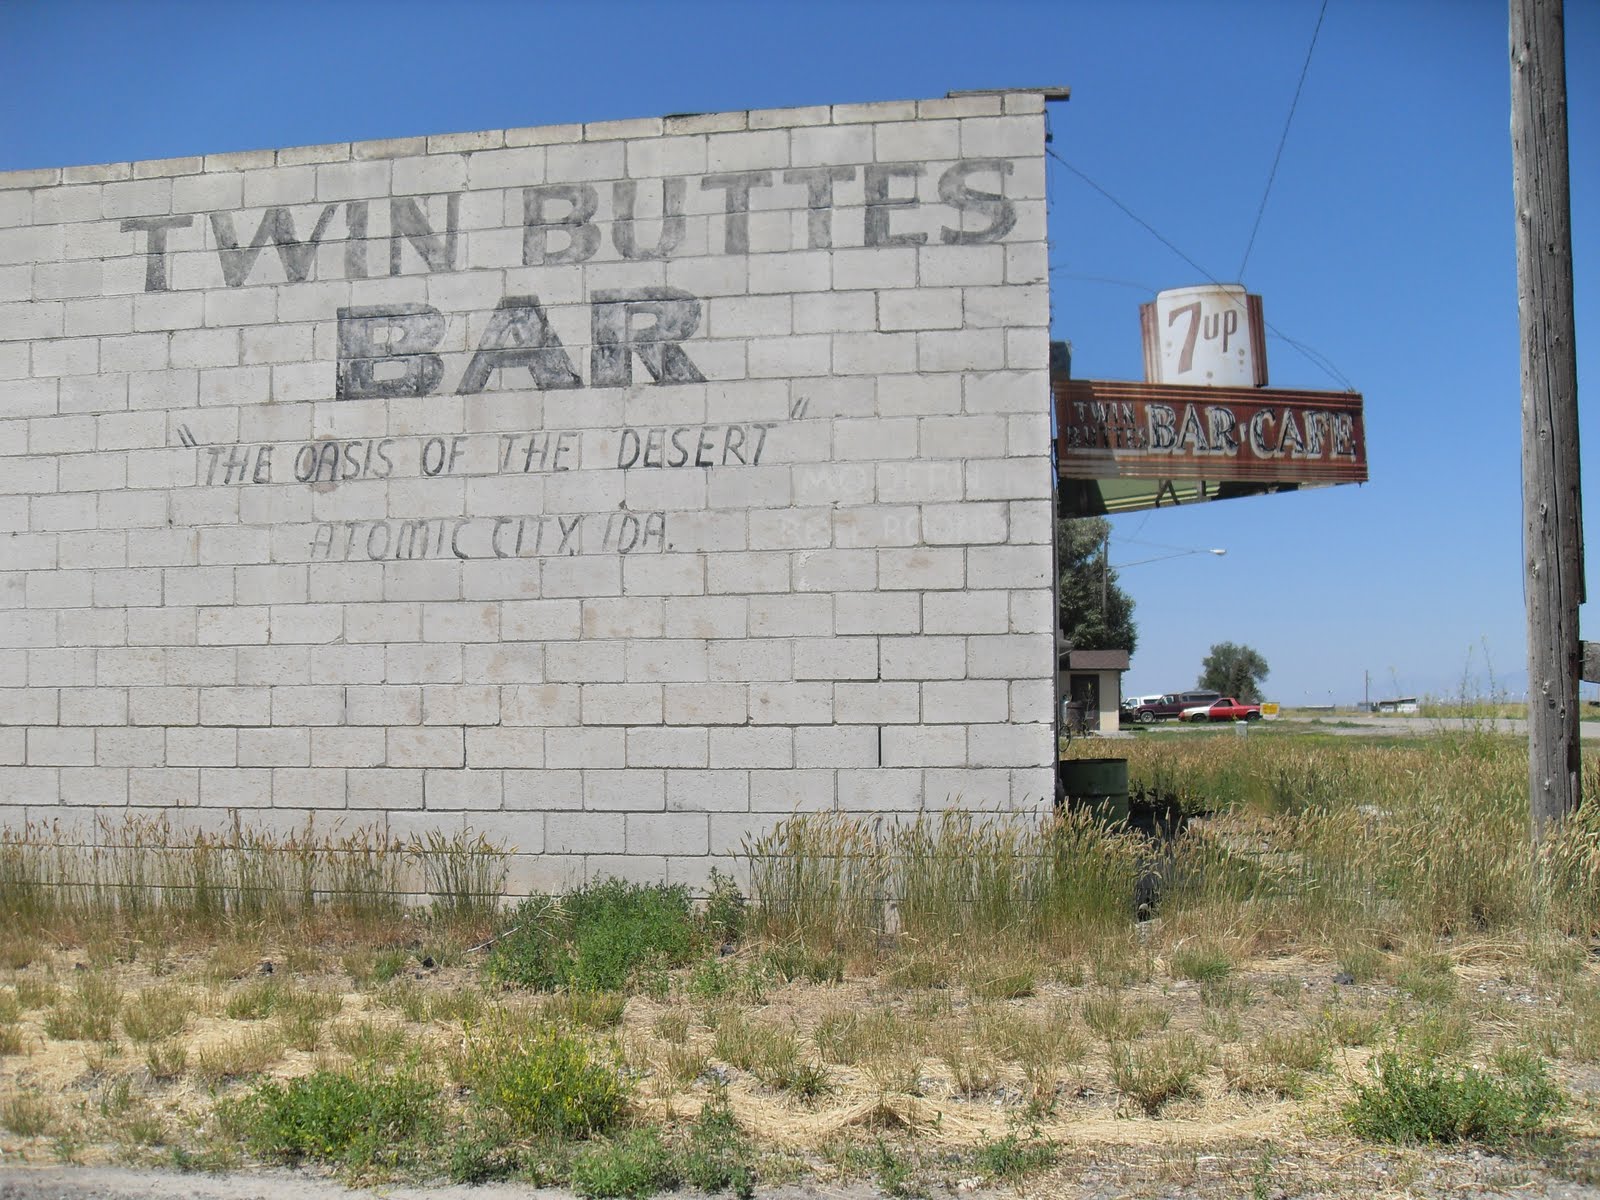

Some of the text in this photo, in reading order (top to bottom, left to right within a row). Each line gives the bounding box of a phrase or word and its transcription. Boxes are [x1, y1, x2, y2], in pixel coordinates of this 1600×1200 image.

[120, 158, 1017, 292] TWIN BUTTES
[336, 285, 708, 401] BAR
[1073, 401, 1136, 424] TWIN
[1145, 402, 1357, 461] BAR CAFE
[294, 437, 396, 483] OASIS
[422, 436, 468, 477] OF
[501, 430, 578, 473] THE
[309, 519, 472, 562] ATOMIC
